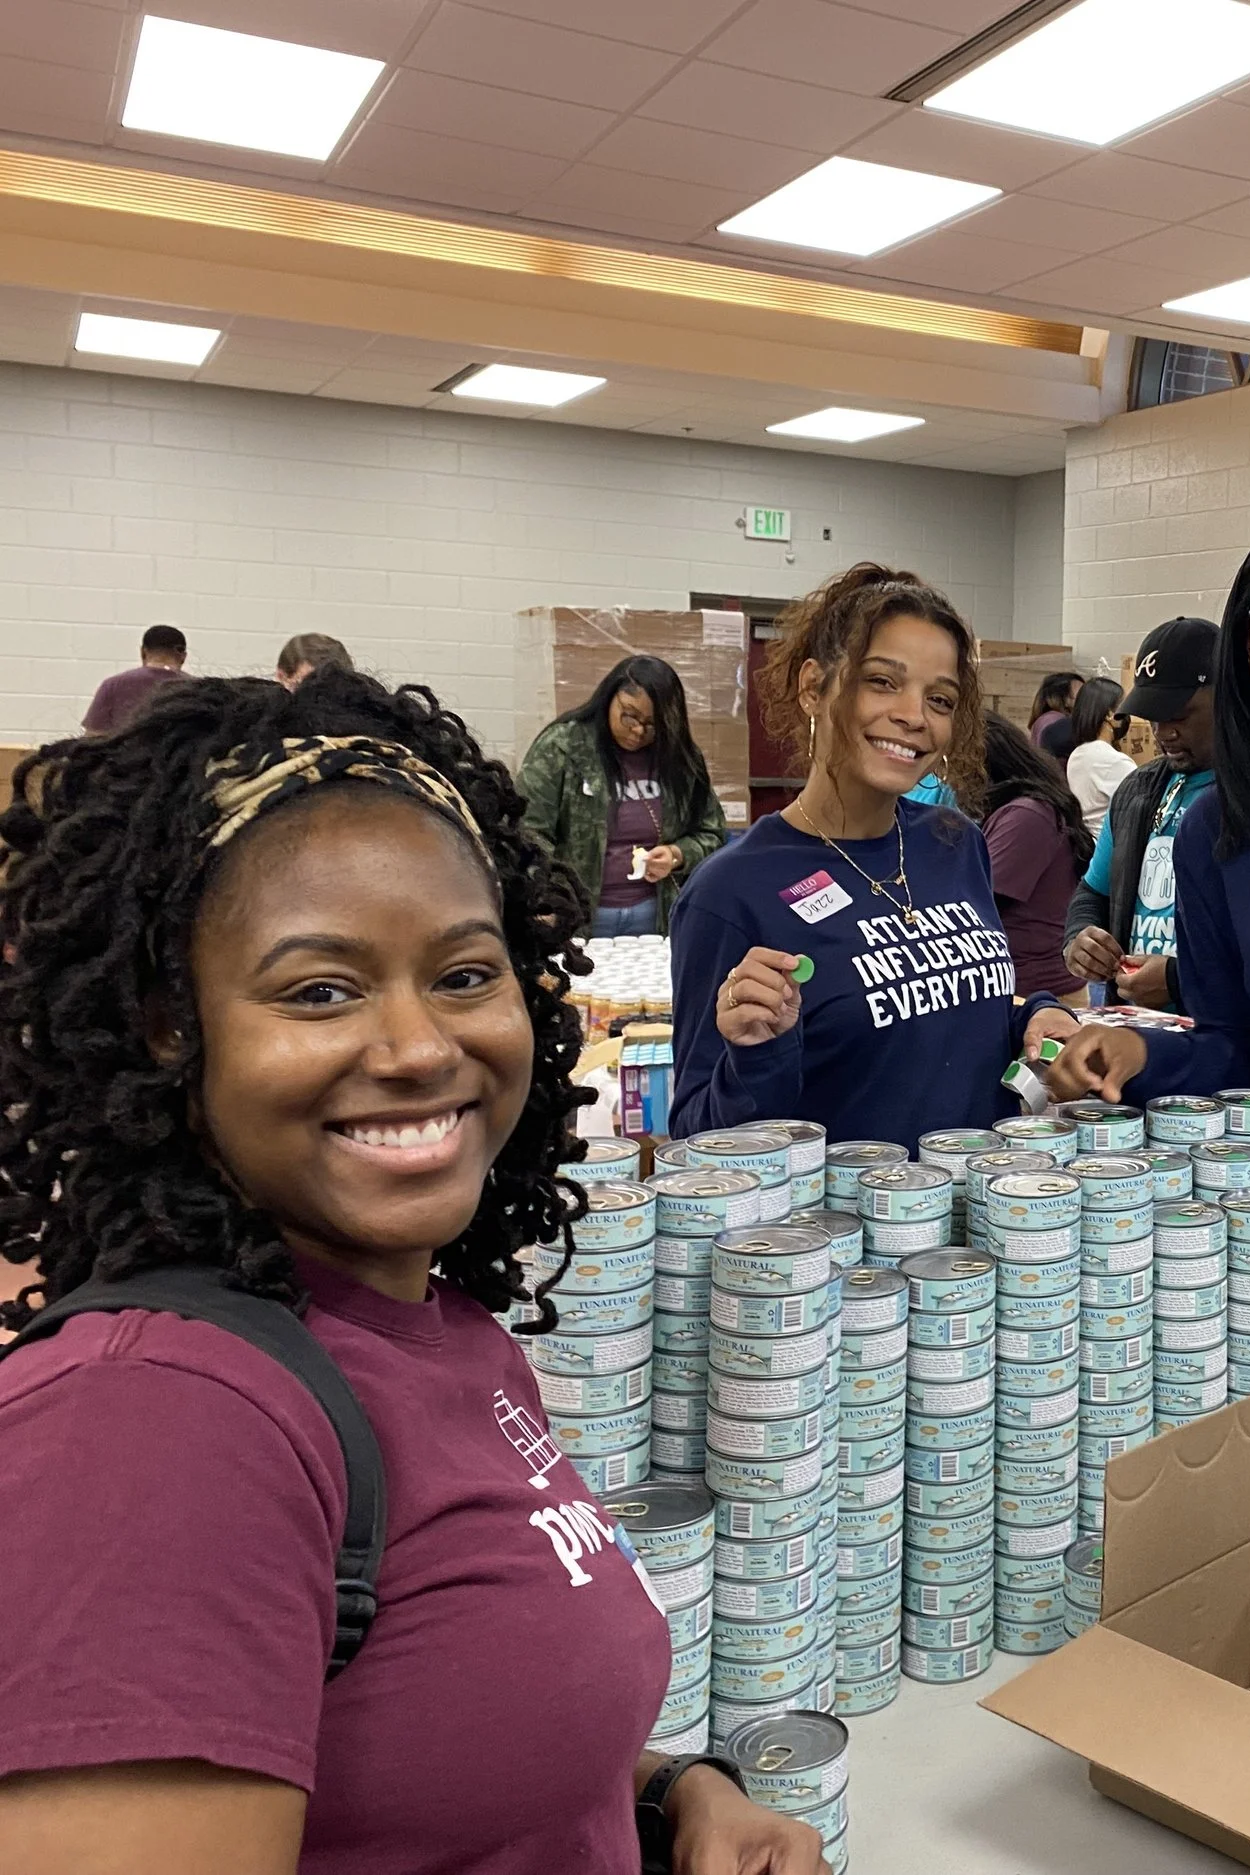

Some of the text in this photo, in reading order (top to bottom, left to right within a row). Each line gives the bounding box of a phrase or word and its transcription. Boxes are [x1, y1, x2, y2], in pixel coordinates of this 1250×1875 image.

[754, 510, 785, 535] EXIT
[790, 879, 817, 896] HELLO
[857, 901, 985, 947] ATLANTA
[866, 962, 1015, 1029] EVERYTHIN
